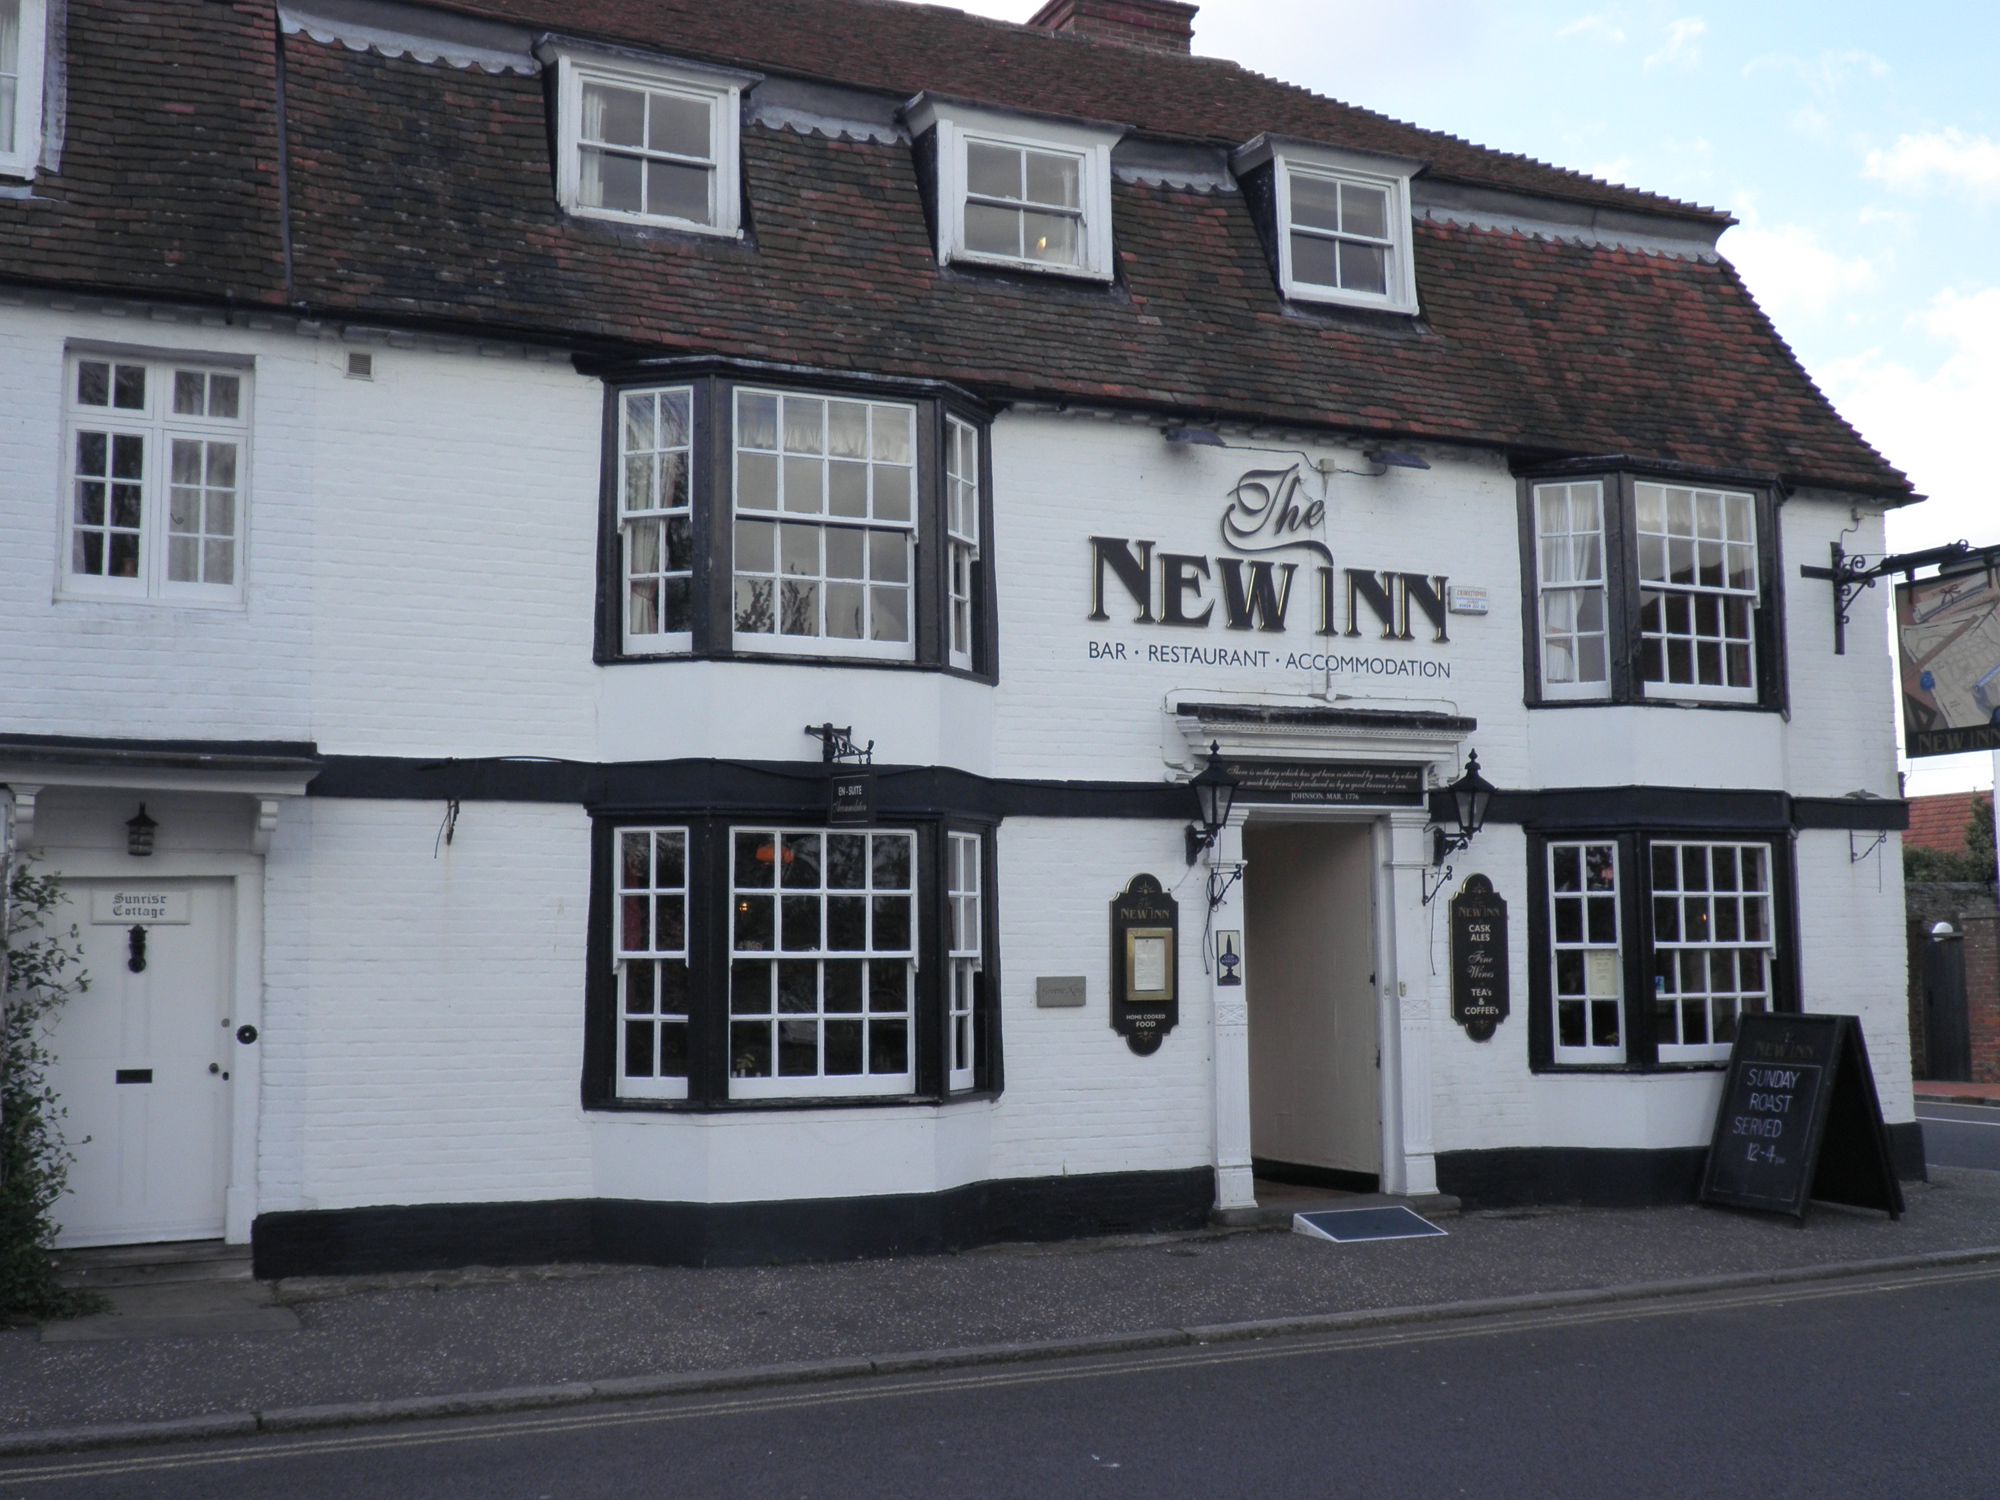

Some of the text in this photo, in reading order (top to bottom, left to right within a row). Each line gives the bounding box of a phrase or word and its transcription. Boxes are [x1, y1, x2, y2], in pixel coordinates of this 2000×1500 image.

[1220, 463, 1334, 566] The
[1088, 535, 1451, 643] NEW INN
[1088, 641, 1451, 679] BAR RESTAURANT ACCOMMODATION
[1918, 731, 1963, 754] NEW
[1256, 768, 1280, 779] nothing
[1345, 793, 1359, 801] 1776
[113, 893, 167, 905] Sunrise
[113, 906, 165, 918] Cottage
[1120, 906, 1170, 921] NEW INN
[1468, 924, 1491, 933] CASK
[1470, 934, 1490, 942] ALES
[1468, 950, 1493, 964] Fine
[1467, 965, 1494, 979] Wines
[1471, 988, 1492, 997] TEA's
[1464, 1006, 1499, 1015] COFFEE's
[1135, 1020, 1156, 1028] FOOD
[1747, 1068, 1800, 1089] SUNDAY
[1749, 1093, 1793, 1113] ROAST
[1732, 1116, 1782, 1138] SERVED
